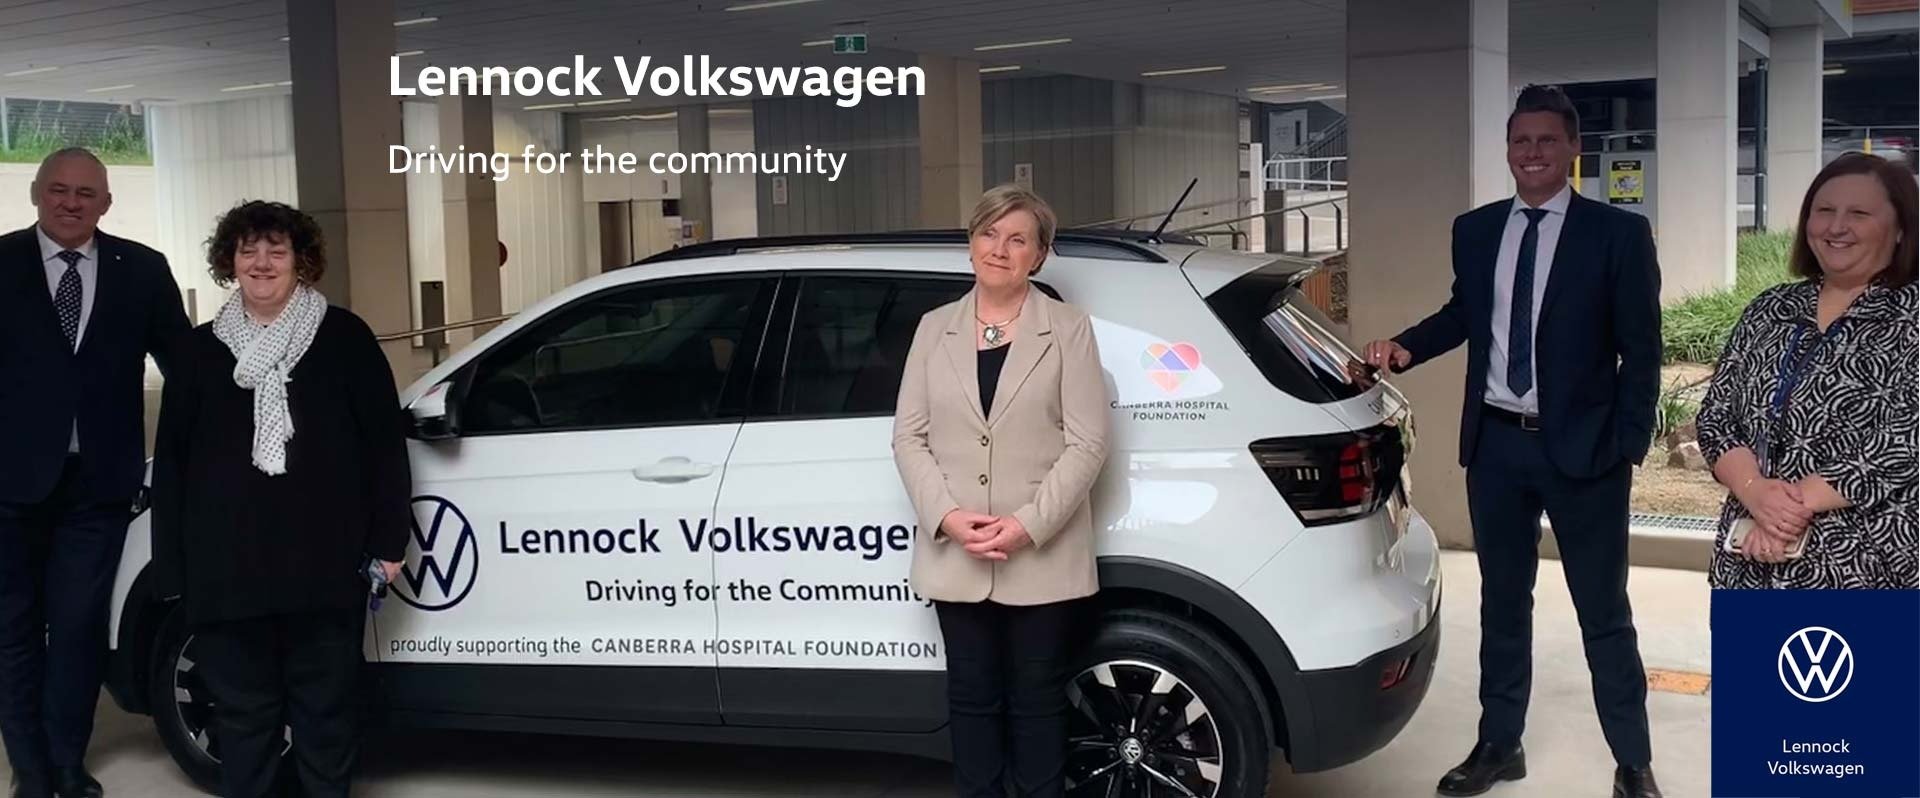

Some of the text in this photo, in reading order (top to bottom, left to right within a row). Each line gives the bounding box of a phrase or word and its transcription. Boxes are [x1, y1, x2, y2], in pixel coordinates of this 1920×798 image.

[1110, 401, 1229, 411] CBERRA HOSPITAL
[1132, 412, 1207, 421] FOUNDATION
[499, 518, 661, 555] Lennock
[585, 578, 934, 608] Driving for the Communi
[390, 635, 938, 659] proudly supporting the CANBERRA HOSPITAL FOUNDATION
